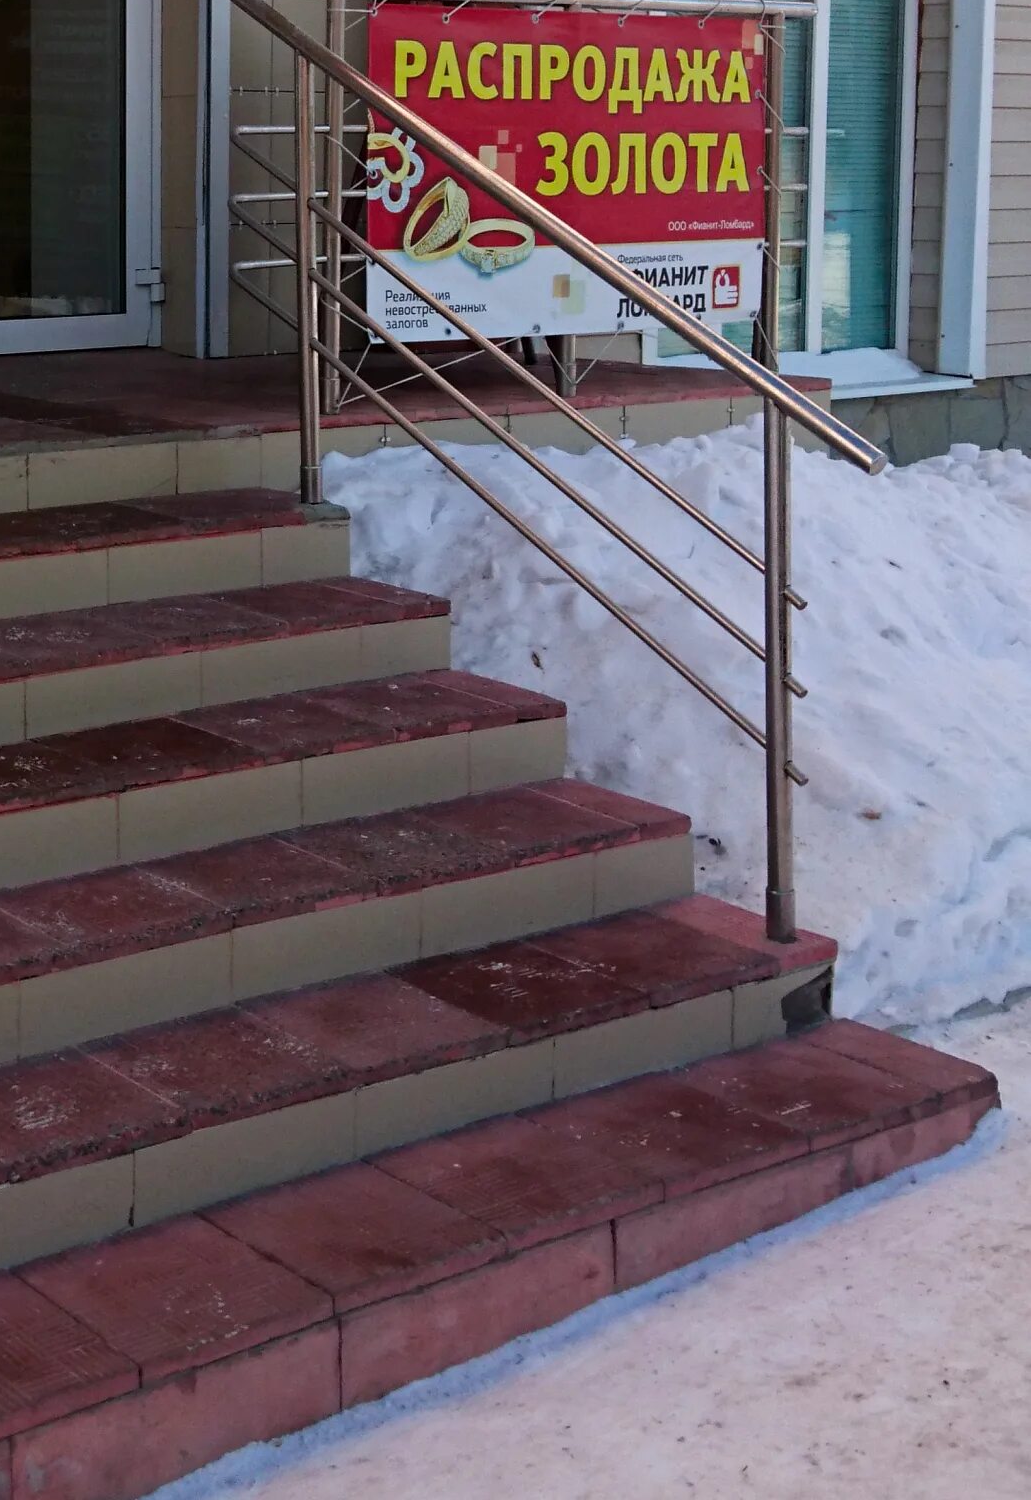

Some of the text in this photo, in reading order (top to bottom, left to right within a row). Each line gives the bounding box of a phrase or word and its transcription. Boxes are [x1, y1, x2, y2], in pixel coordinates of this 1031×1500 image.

[394, 39, 751, 114] РАСПРОДАЖА
[535, 131, 750, 197] ЗОЛОТА
[668, 221, 687, 231] ООО
[668, 254, 683, 262] сеть
[386, 290, 450, 302] Реалиция
[386, 319, 428, 329] залогов
